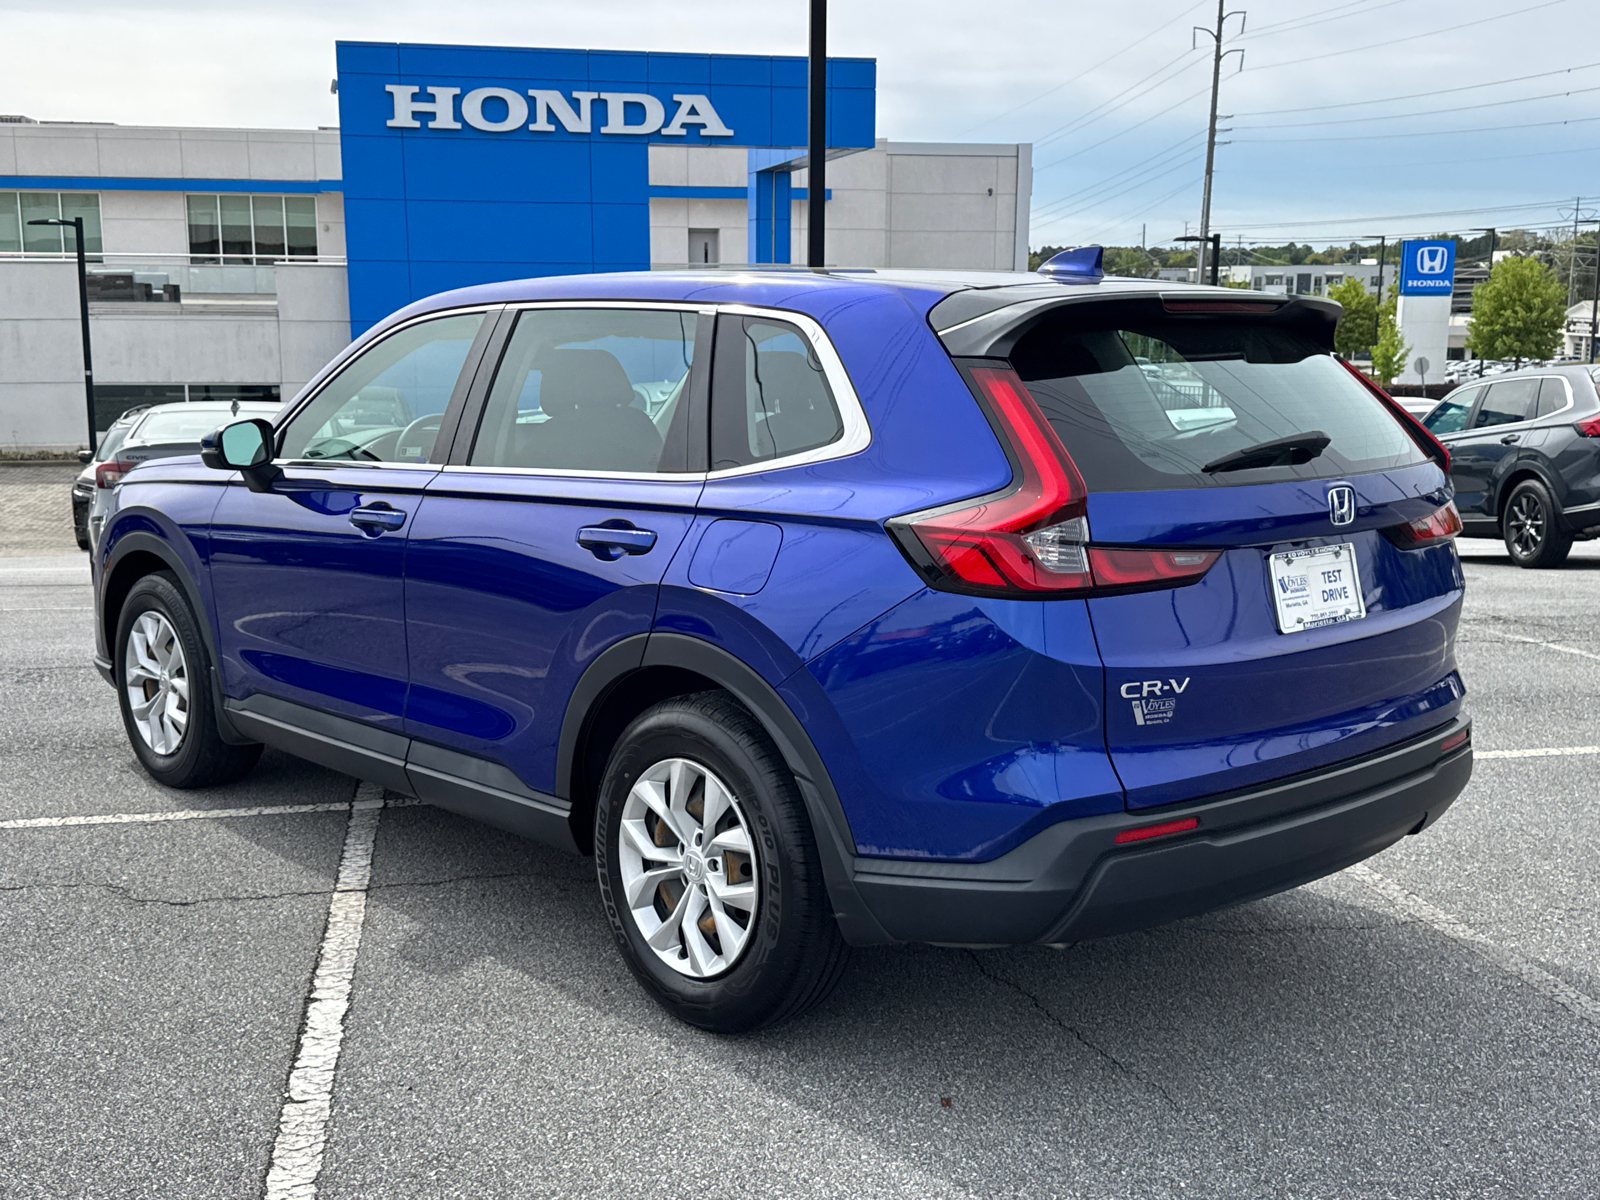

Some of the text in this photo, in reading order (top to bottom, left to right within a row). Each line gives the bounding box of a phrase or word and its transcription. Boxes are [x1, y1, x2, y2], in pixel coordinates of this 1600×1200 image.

[385, 84, 735, 137] HONDA
[1407, 279, 1452, 287] HONDA
[1321, 569, 1342, 584] TEST
[1321, 586, 1349, 603] DRIVE
[1120, 677, 1190, 698] CR-V
[1141, 698, 1175, 714] VOYLES
[757, 814, 775, 850] 010
[765, 862, 780, 941] PLUS
